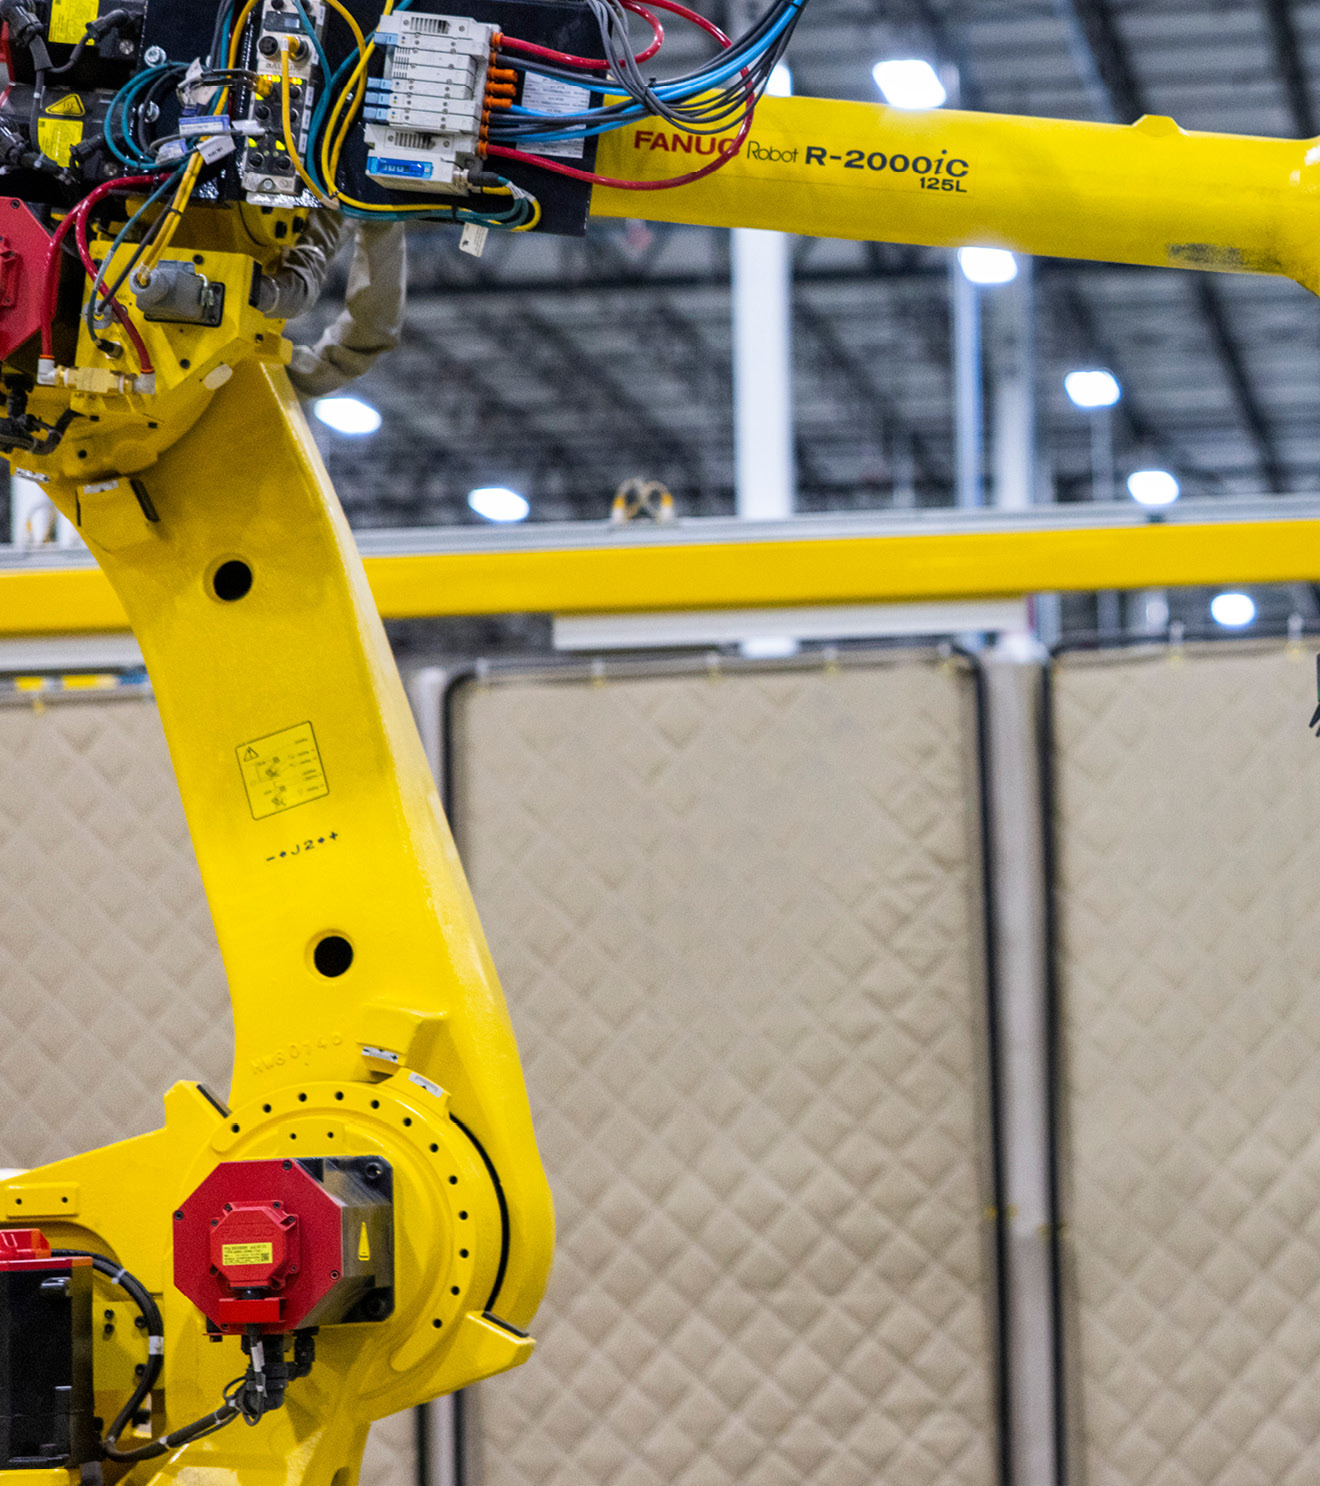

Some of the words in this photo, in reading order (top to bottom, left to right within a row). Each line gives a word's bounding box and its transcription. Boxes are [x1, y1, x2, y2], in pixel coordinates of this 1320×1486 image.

[633, 130, 740, 157] FANUC
[747, 140, 799, 163] Robot
[804, 145, 969, 178] R-2000iC
[919, 177, 968, 193] 125L
